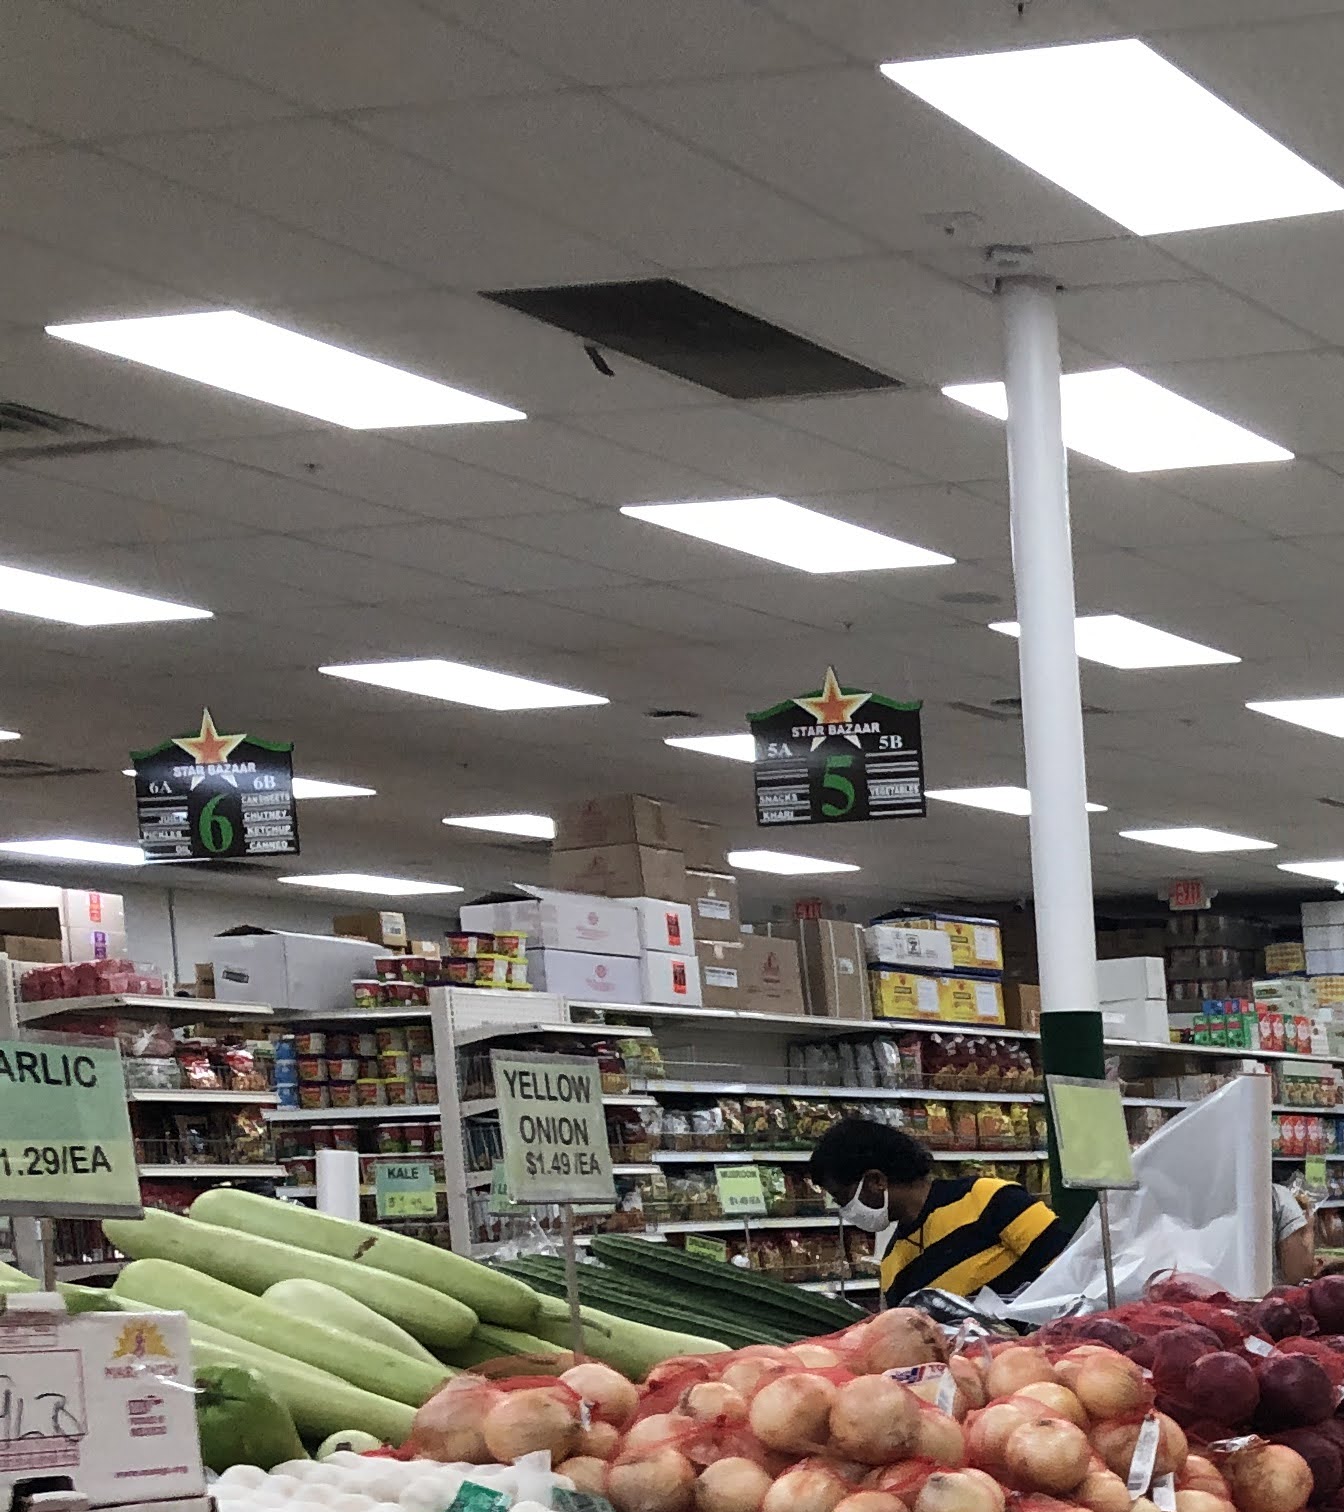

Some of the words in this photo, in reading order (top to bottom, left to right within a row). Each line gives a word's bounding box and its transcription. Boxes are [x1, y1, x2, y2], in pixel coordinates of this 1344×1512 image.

[791, 724, 825, 738] STAR
[828, 722, 880, 736] BAZAAR
[767, 742, 793, 758] 5A
[878, 734, 904, 750] 5B
[172, 764, 206, 778] STAR
[207, 761, 257, 776] BAZAAR
[149, 780, 173, 795] 6A
[253, 775, 277, 790] 6B
[821, 754, 856, 817] 5
[198, 792, 234, 853] 6
[502, 1069, 592, 1104] YELLOW
[519, 1114, 590, 1147] ONION
[386, 1167, 420, 1181] KALE
